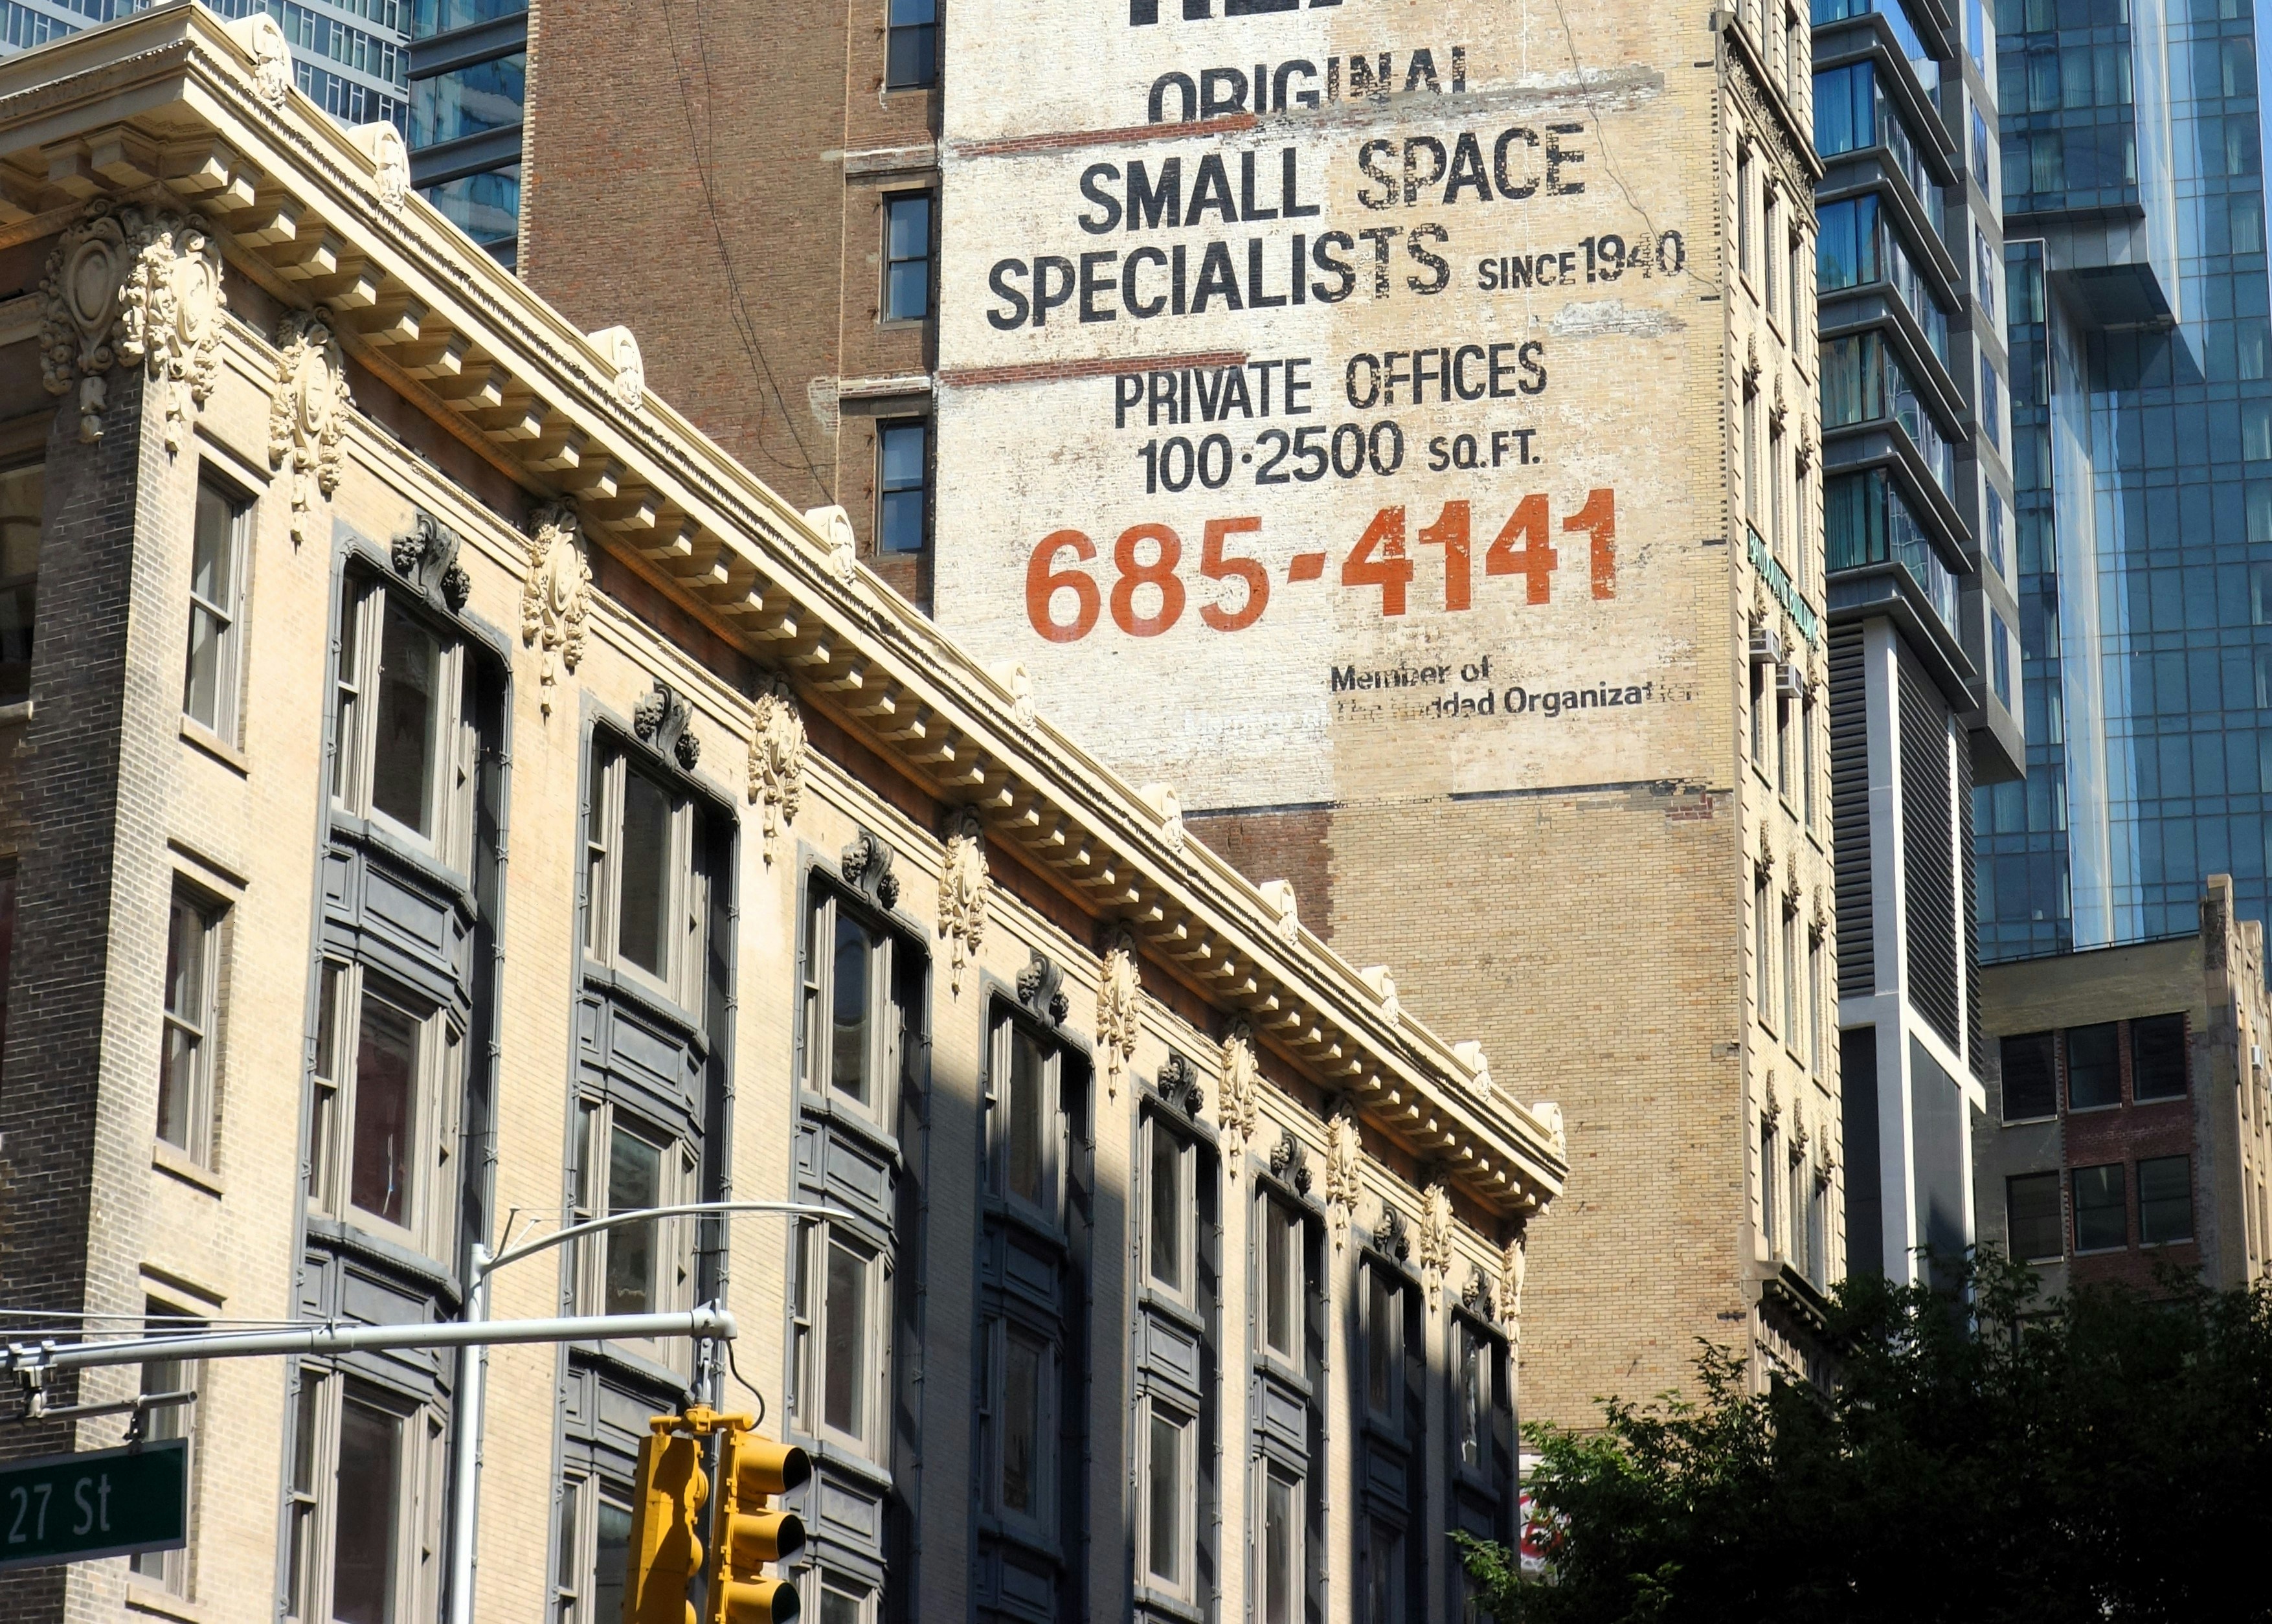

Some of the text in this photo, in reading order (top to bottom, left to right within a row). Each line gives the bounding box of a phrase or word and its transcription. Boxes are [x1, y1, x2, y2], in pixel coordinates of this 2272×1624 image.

[1078, 123, 1585, 234] SMALL SPACE
[987, 223, 1685, 330] SPECIALISTS SINCE 1940
[1115, 341, 1547, 429] PRIVATE OFFICES
[1025, 489, 1615, 643] 685-4141
[1460, 655, 1493, 682] of
[1504, 681, 1699, 717] Organizat
[8, 1473, 111, 1544] 27 St
